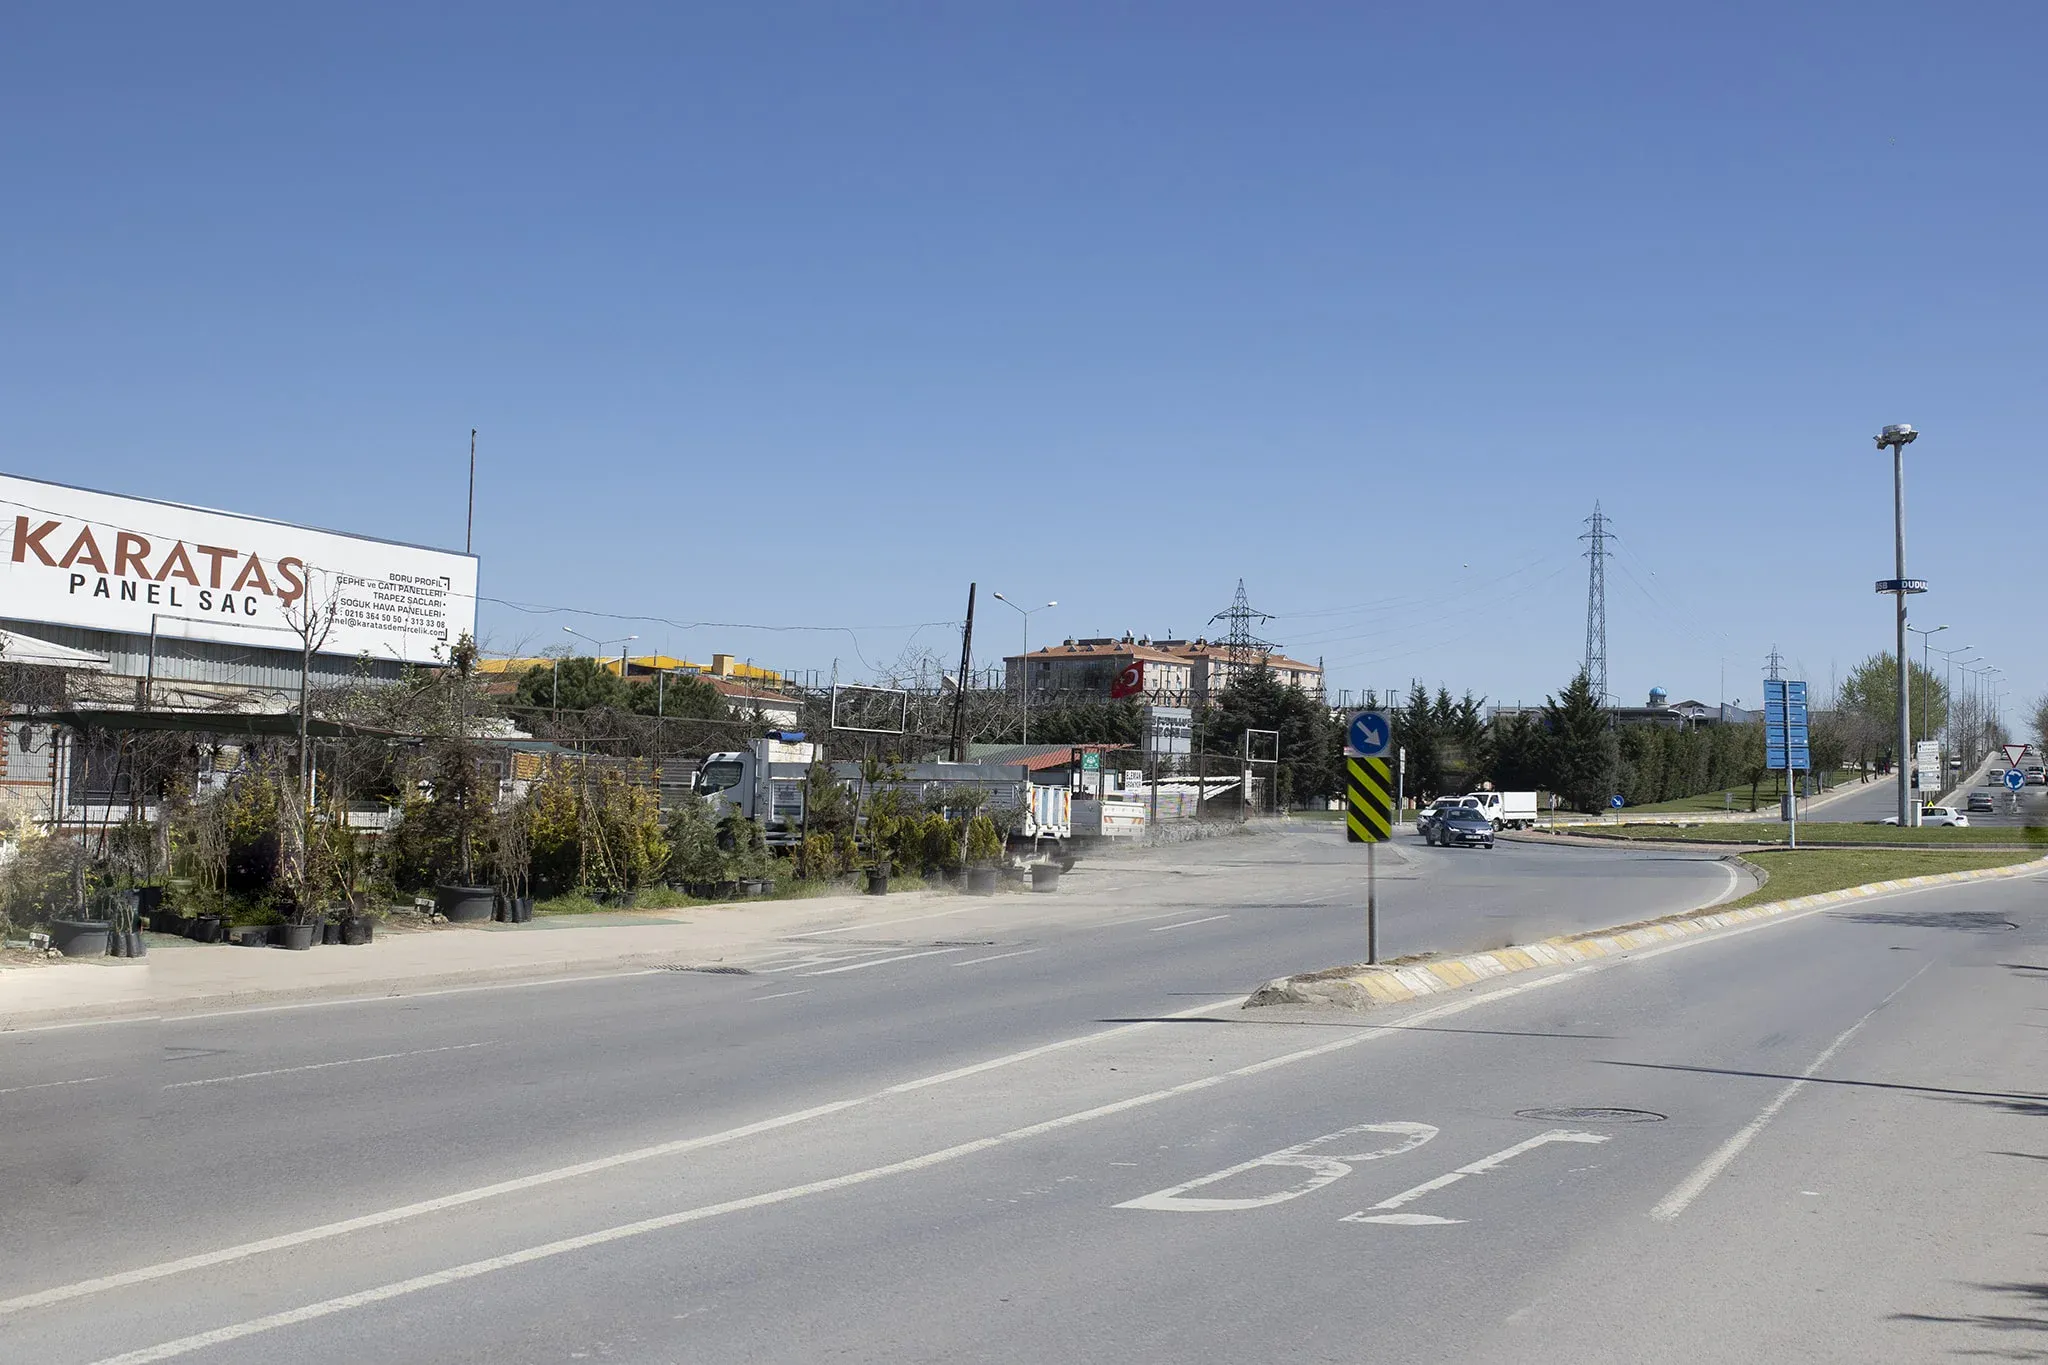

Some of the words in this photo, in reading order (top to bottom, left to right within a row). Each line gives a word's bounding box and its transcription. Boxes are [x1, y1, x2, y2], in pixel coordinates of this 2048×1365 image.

[11, 515, 305, 607] KARATAŞ
[389, 573, 413, 583] BORU
[69, 573, 183, 607] PANEL
[199, 590, 258, 617] SAC
[373, 592, 405, 603] TRAPEZ
[373, 602, 395, 612] HAVA
[344, 609, 364, 618] 0216
[366, 611, 380, 620] 364
[382, 614, 391, 622] 50
[393, 615, 402, 623] 50
[410, 617, 424, 626] 313
